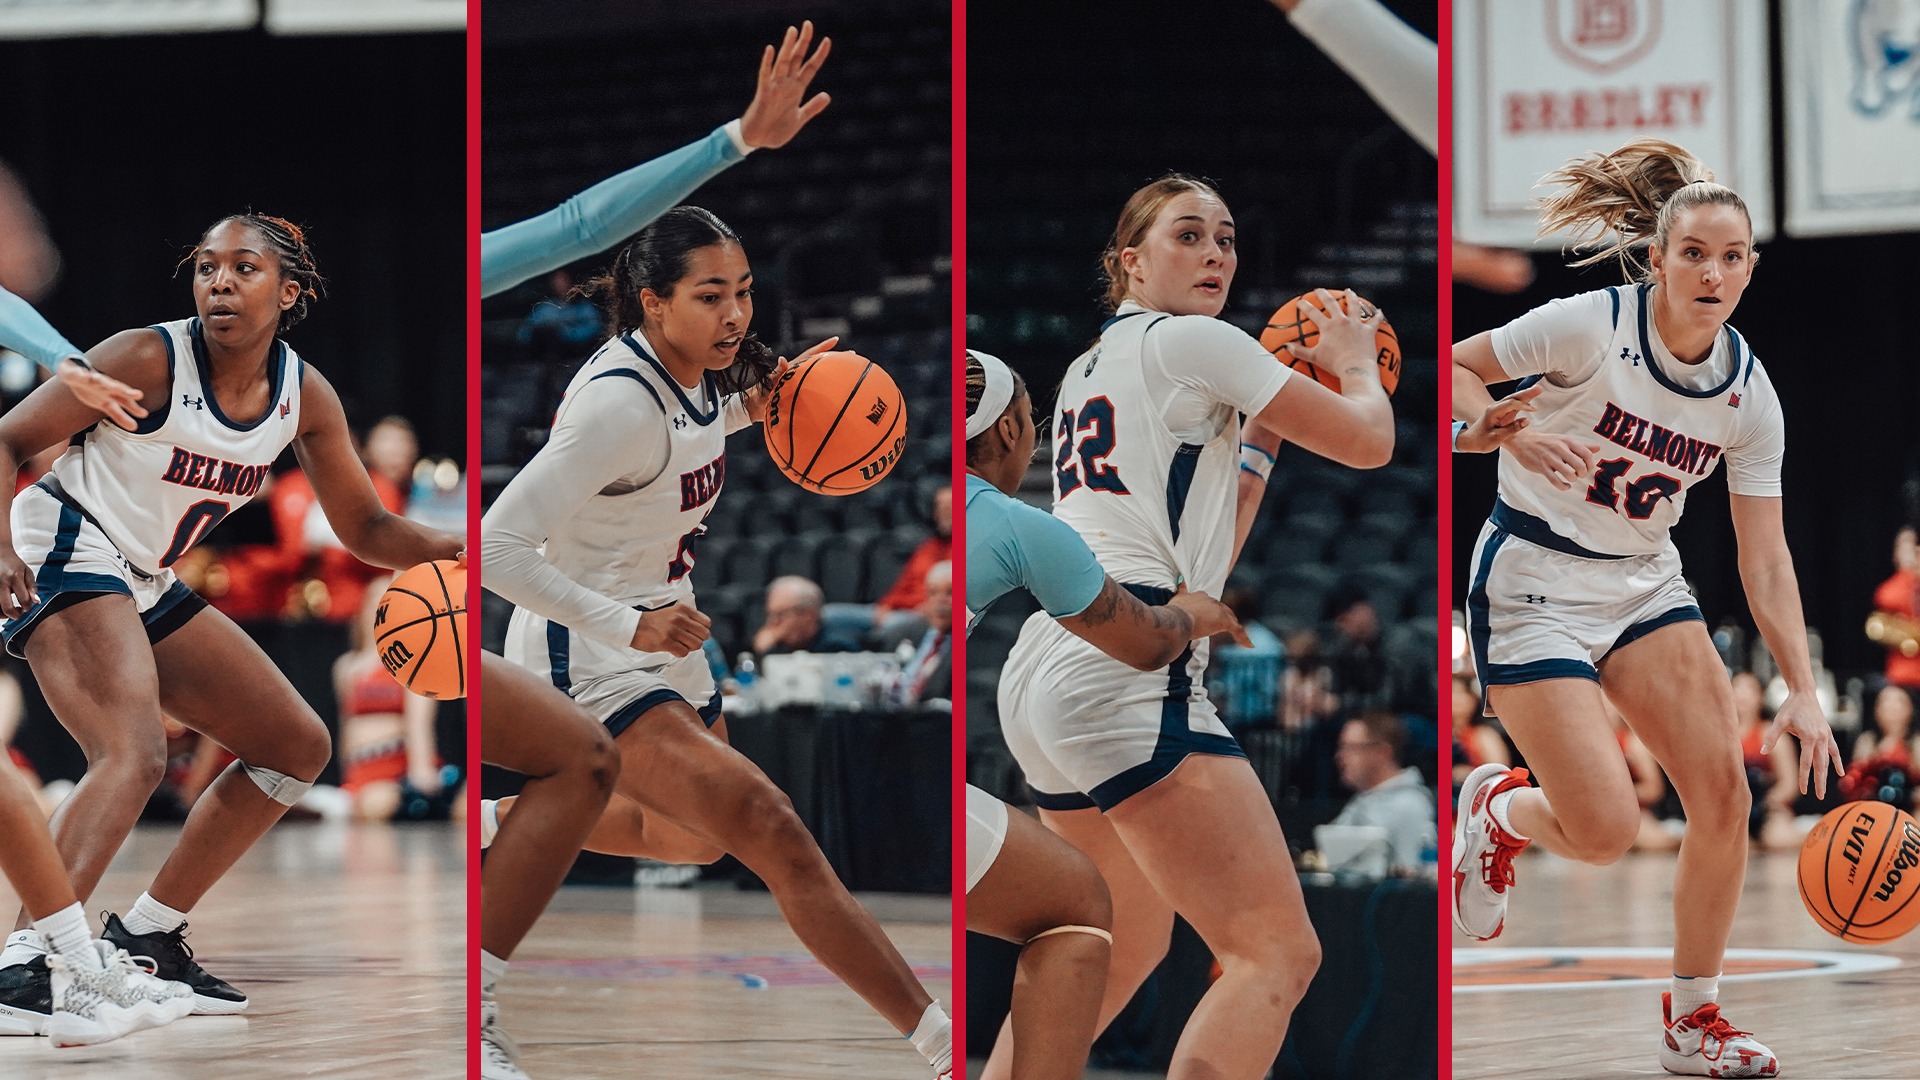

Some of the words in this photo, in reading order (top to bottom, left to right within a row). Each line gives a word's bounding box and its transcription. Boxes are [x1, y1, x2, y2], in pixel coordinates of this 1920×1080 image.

[1505, 83, 1710, 136] BRADLEY
[1056, 394, 1132, 502] 22
[1593, 400, 1722, 476] BELMONT
[161, 445, 276, 497] BELMON
[1585, 456, 1682, 521] 10
[159, 498, 231, 569] 0
[1843, 812, 1876, 865] EVO
